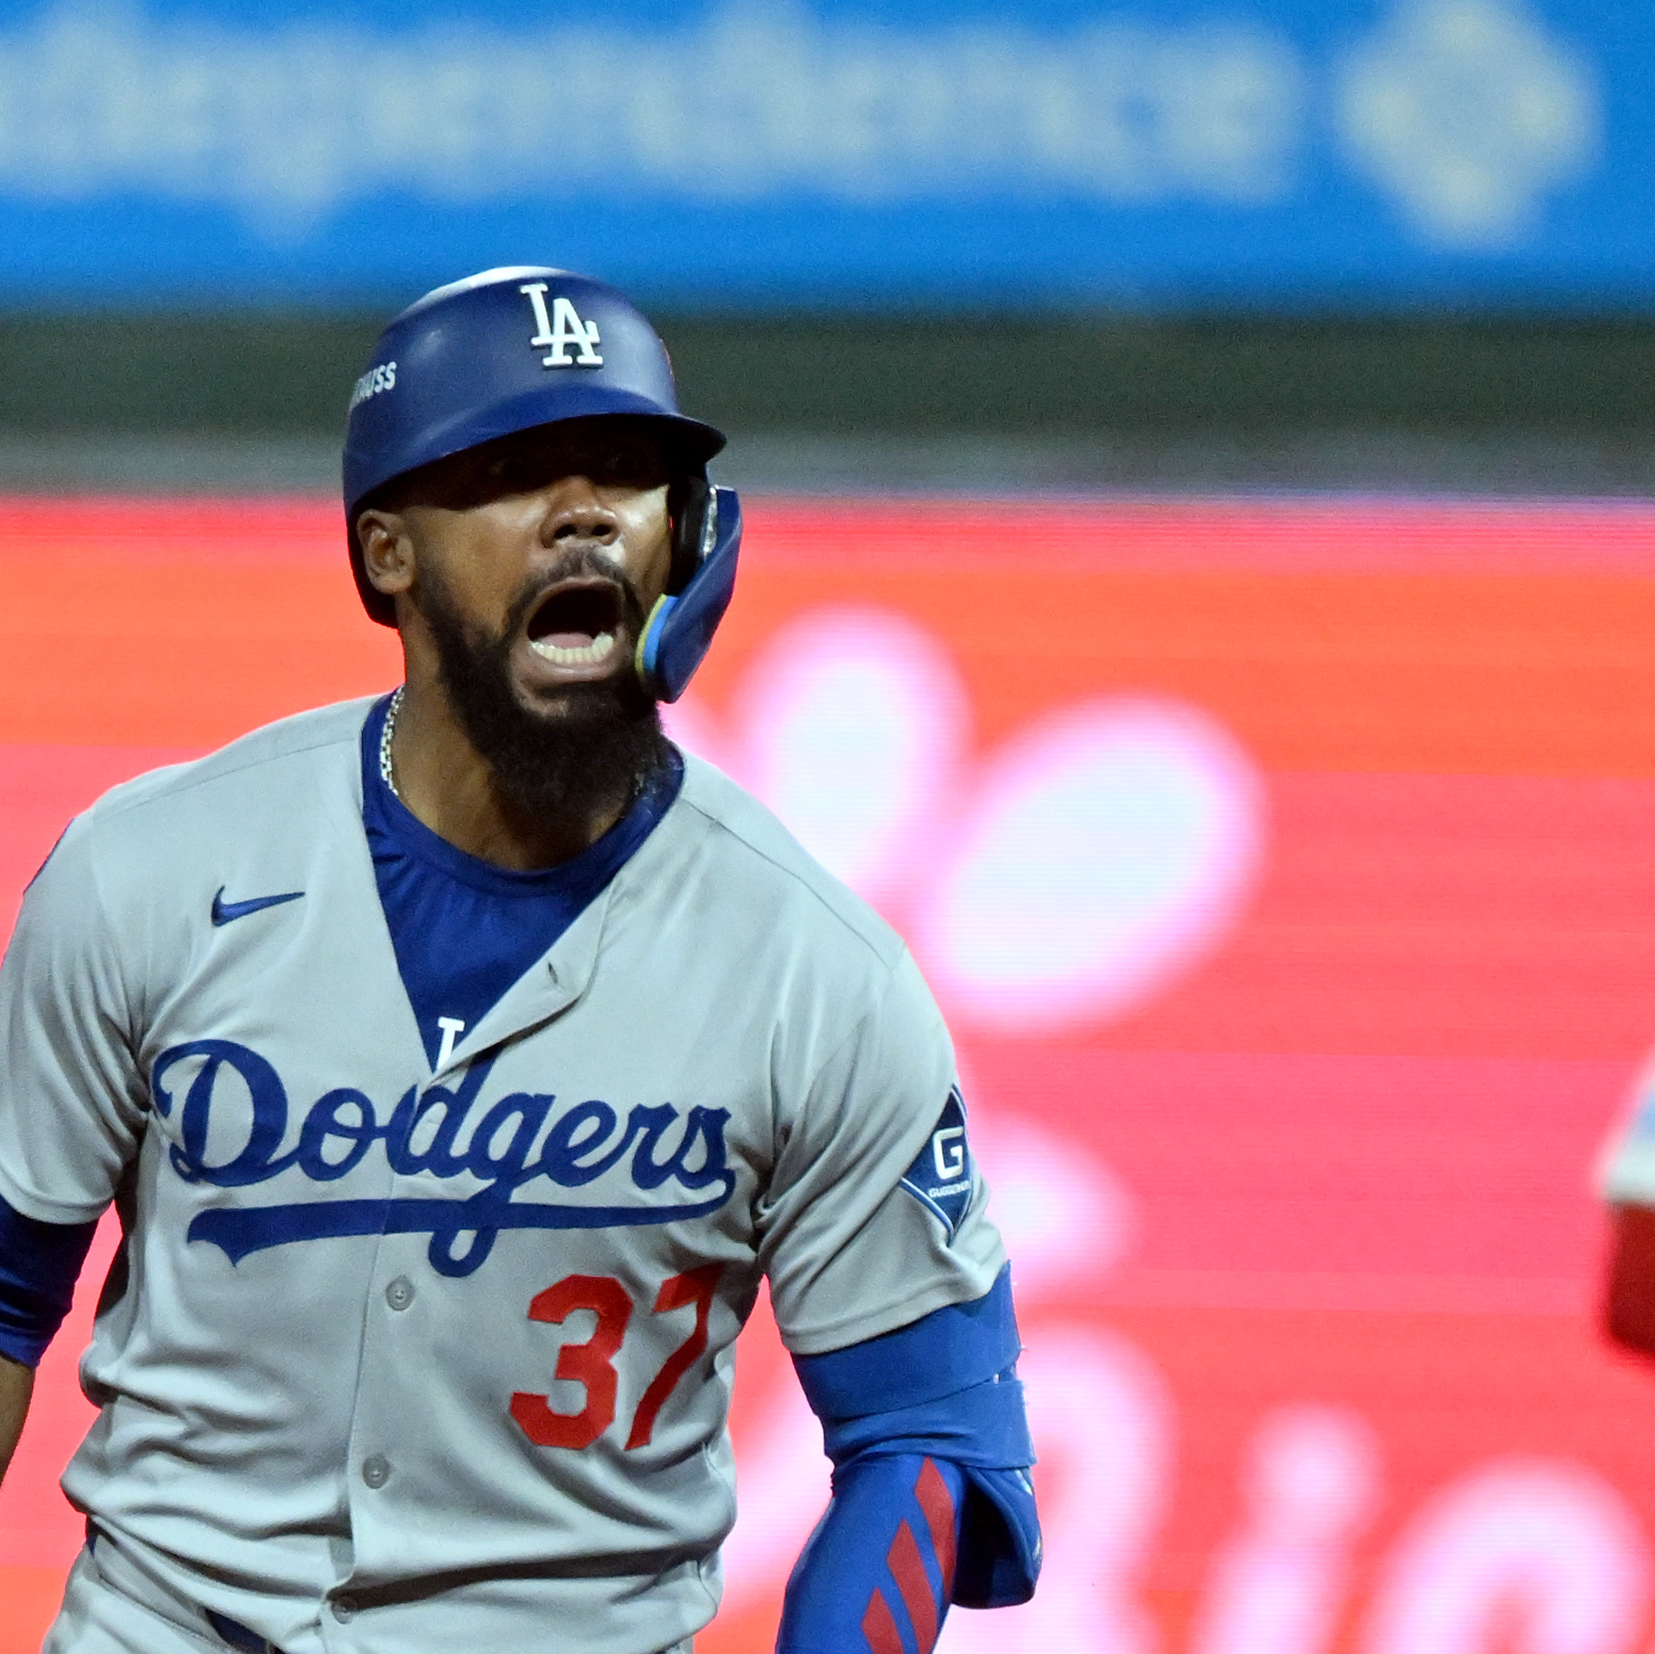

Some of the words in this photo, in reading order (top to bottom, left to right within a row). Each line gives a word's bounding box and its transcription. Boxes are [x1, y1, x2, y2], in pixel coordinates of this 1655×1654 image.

[520, 283, 603, 366] LA
[152, 1038, 735, 1277] Dodgers
[933, 1126, 964, 1180] G
[510, 1262, 724, 1451] 37
